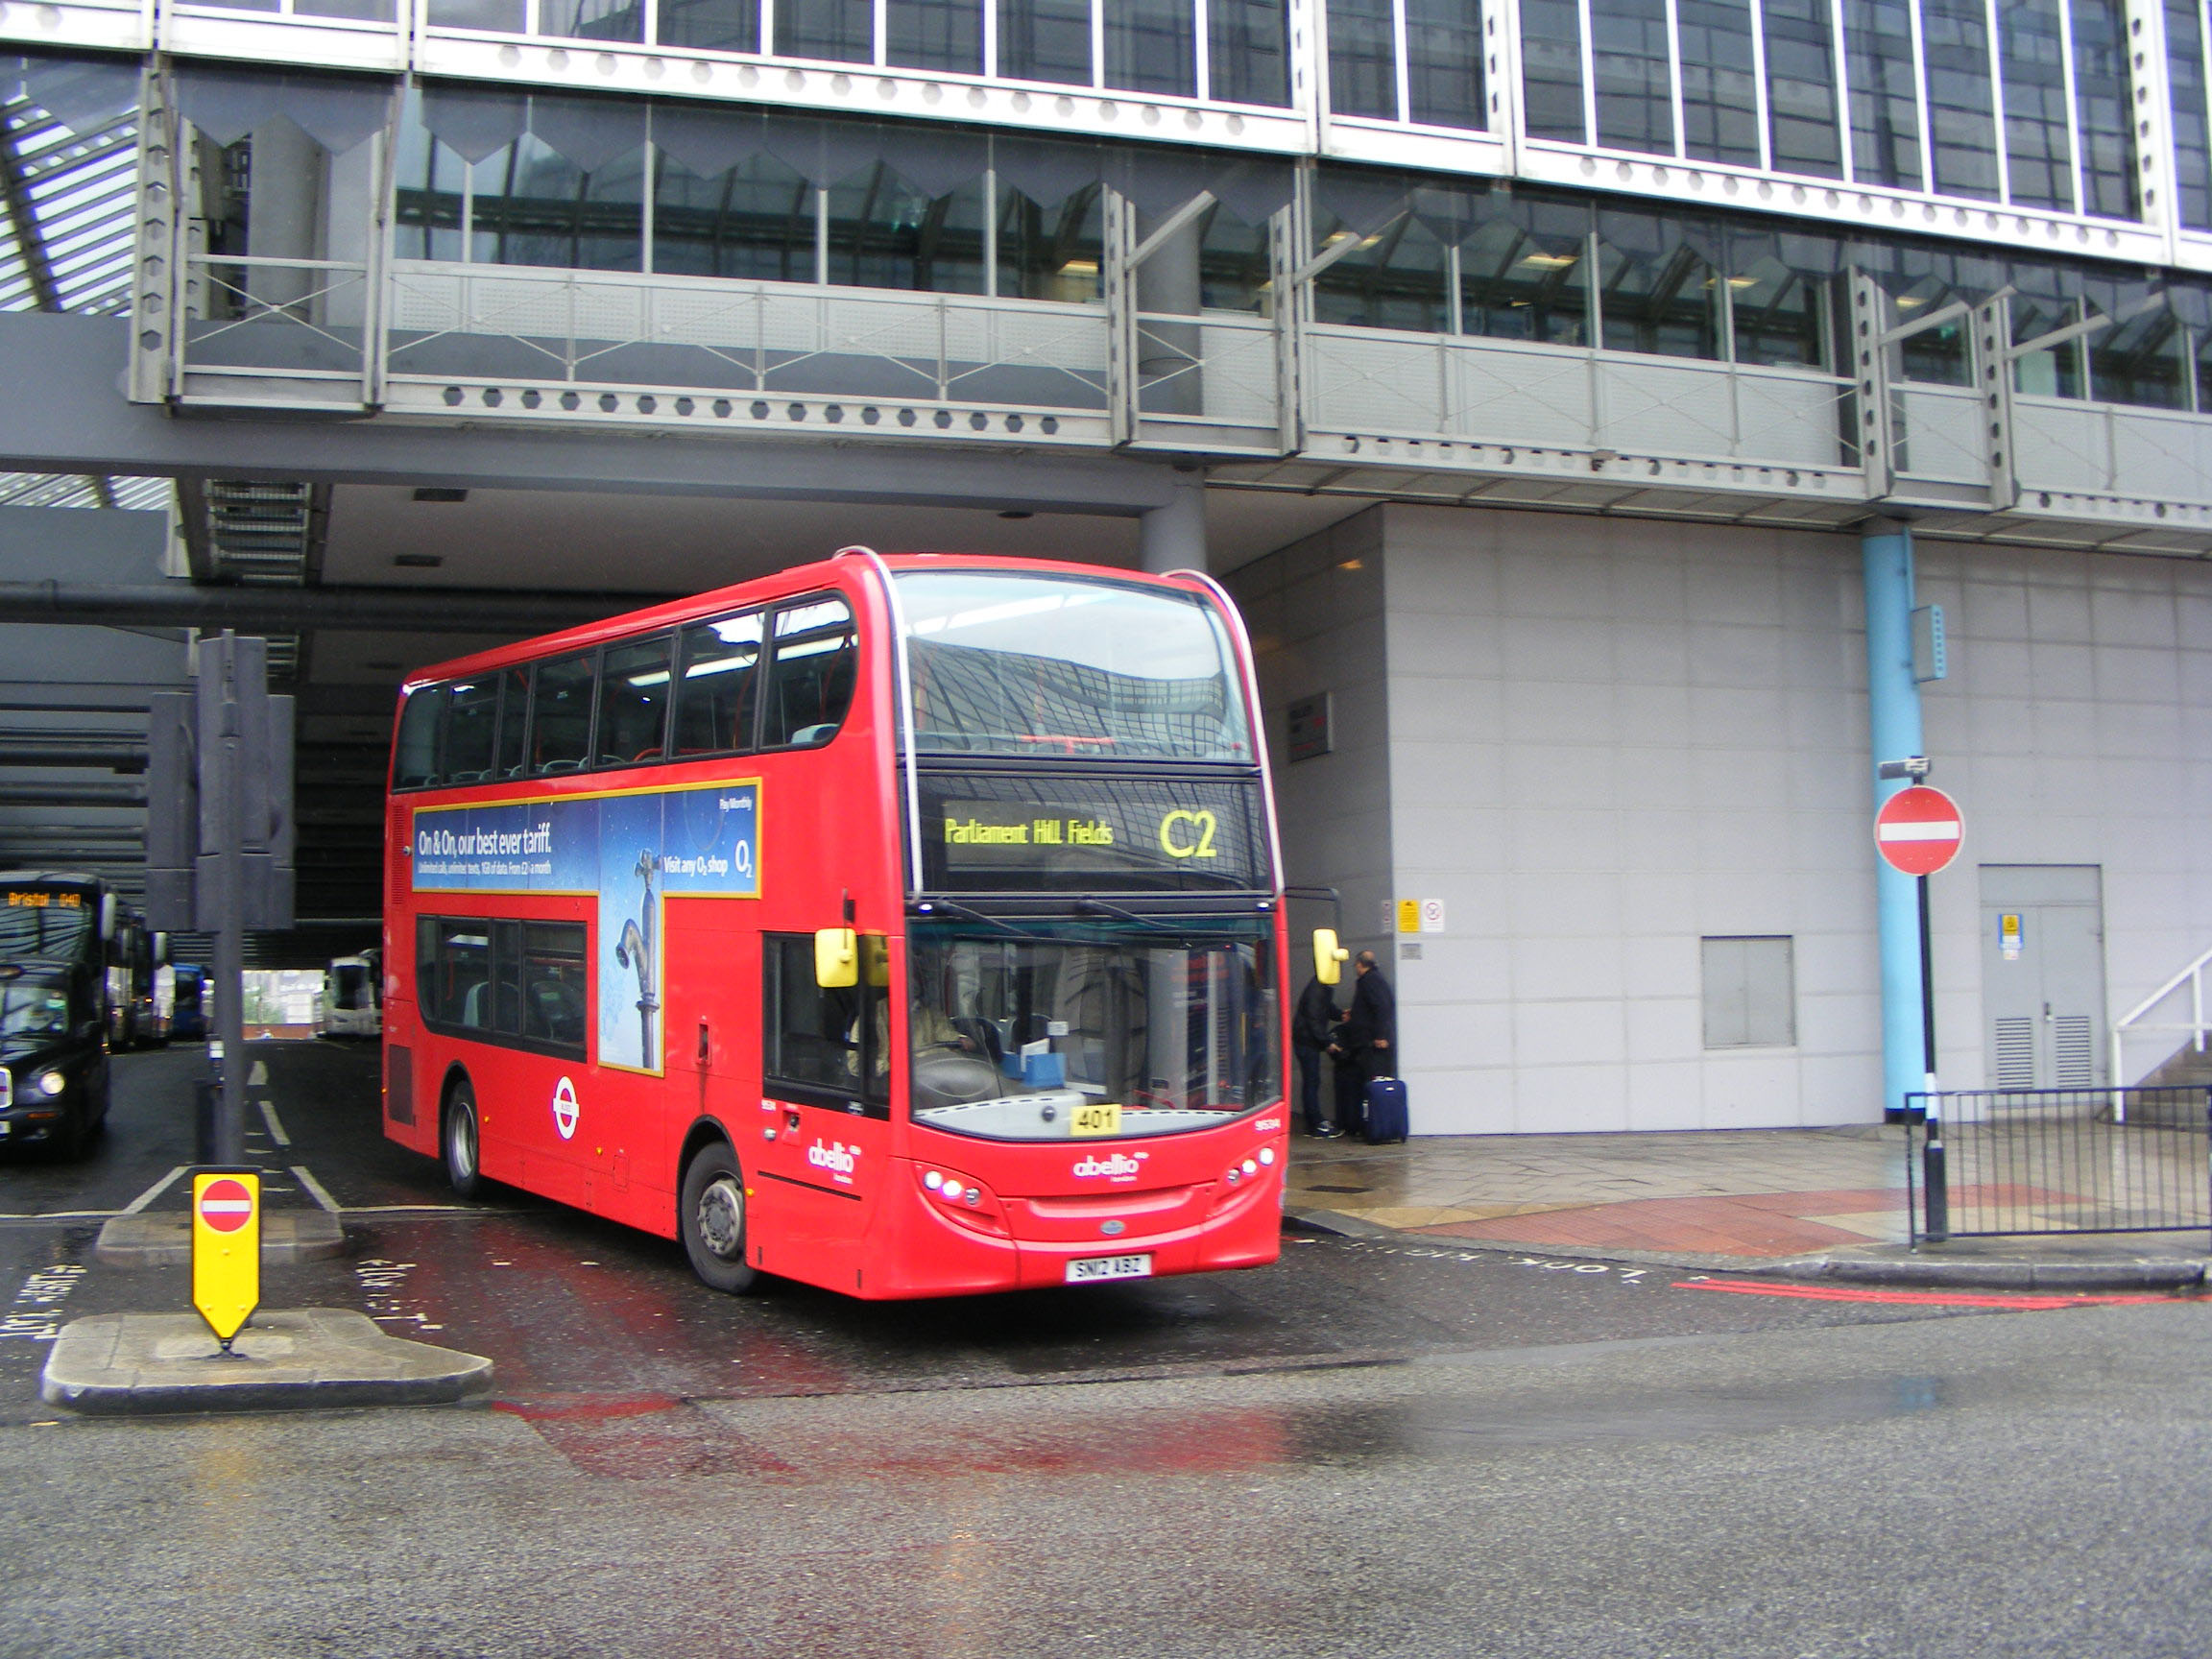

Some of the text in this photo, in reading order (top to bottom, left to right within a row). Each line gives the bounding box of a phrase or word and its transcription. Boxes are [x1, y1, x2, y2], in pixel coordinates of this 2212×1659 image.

[419, 822, 552, 858] On & On, our best ever tariff.
[945, 818, 1114, 845] Parliament Hill Fields
[1160, 809, 1217, 858] C2
[663, 855, 681, 874] Visit
[681, 859, 696, 878] any
[708, 854, 729, 878] shop
[9, 892, 49, 906] Bristol
[1077, 1109, 1114, 1129] 401
[808, 1138, 854, 1173] abellio
[1073, 1153, 1140, 1176] abellio
[1075, 1260, 1108, 1277] SN12
[1510, 1258, 1647, 1279] LOOK
